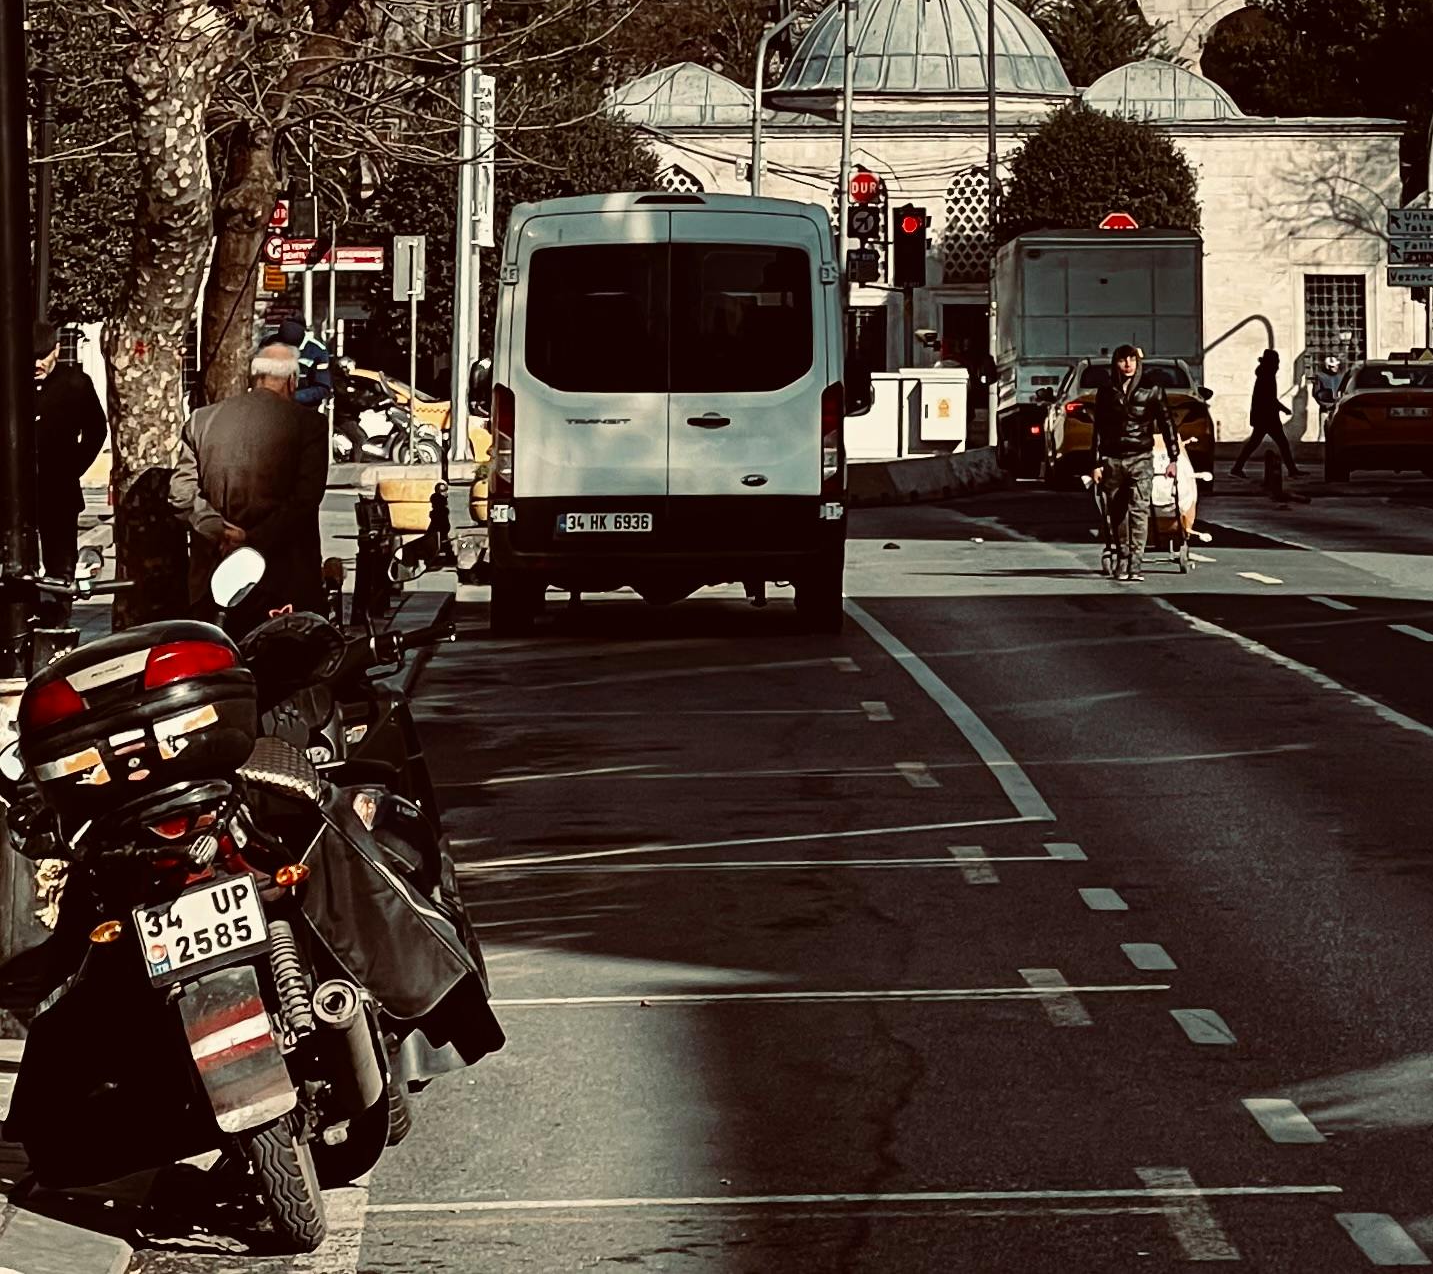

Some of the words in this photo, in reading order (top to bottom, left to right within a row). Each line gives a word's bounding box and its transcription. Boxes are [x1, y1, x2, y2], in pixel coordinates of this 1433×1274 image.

[851, 181, 877, 194] DUR
[272, 208, 287, 219] UR
[568, 515, 585, 531] 34
[590, 514, 608, 530] HK
[614, 514, 649, 530] 6936
[145, 910, 183, 938] 34
[211, 884, 249, 914] UP
[175, 915, 252, 964] 2585
